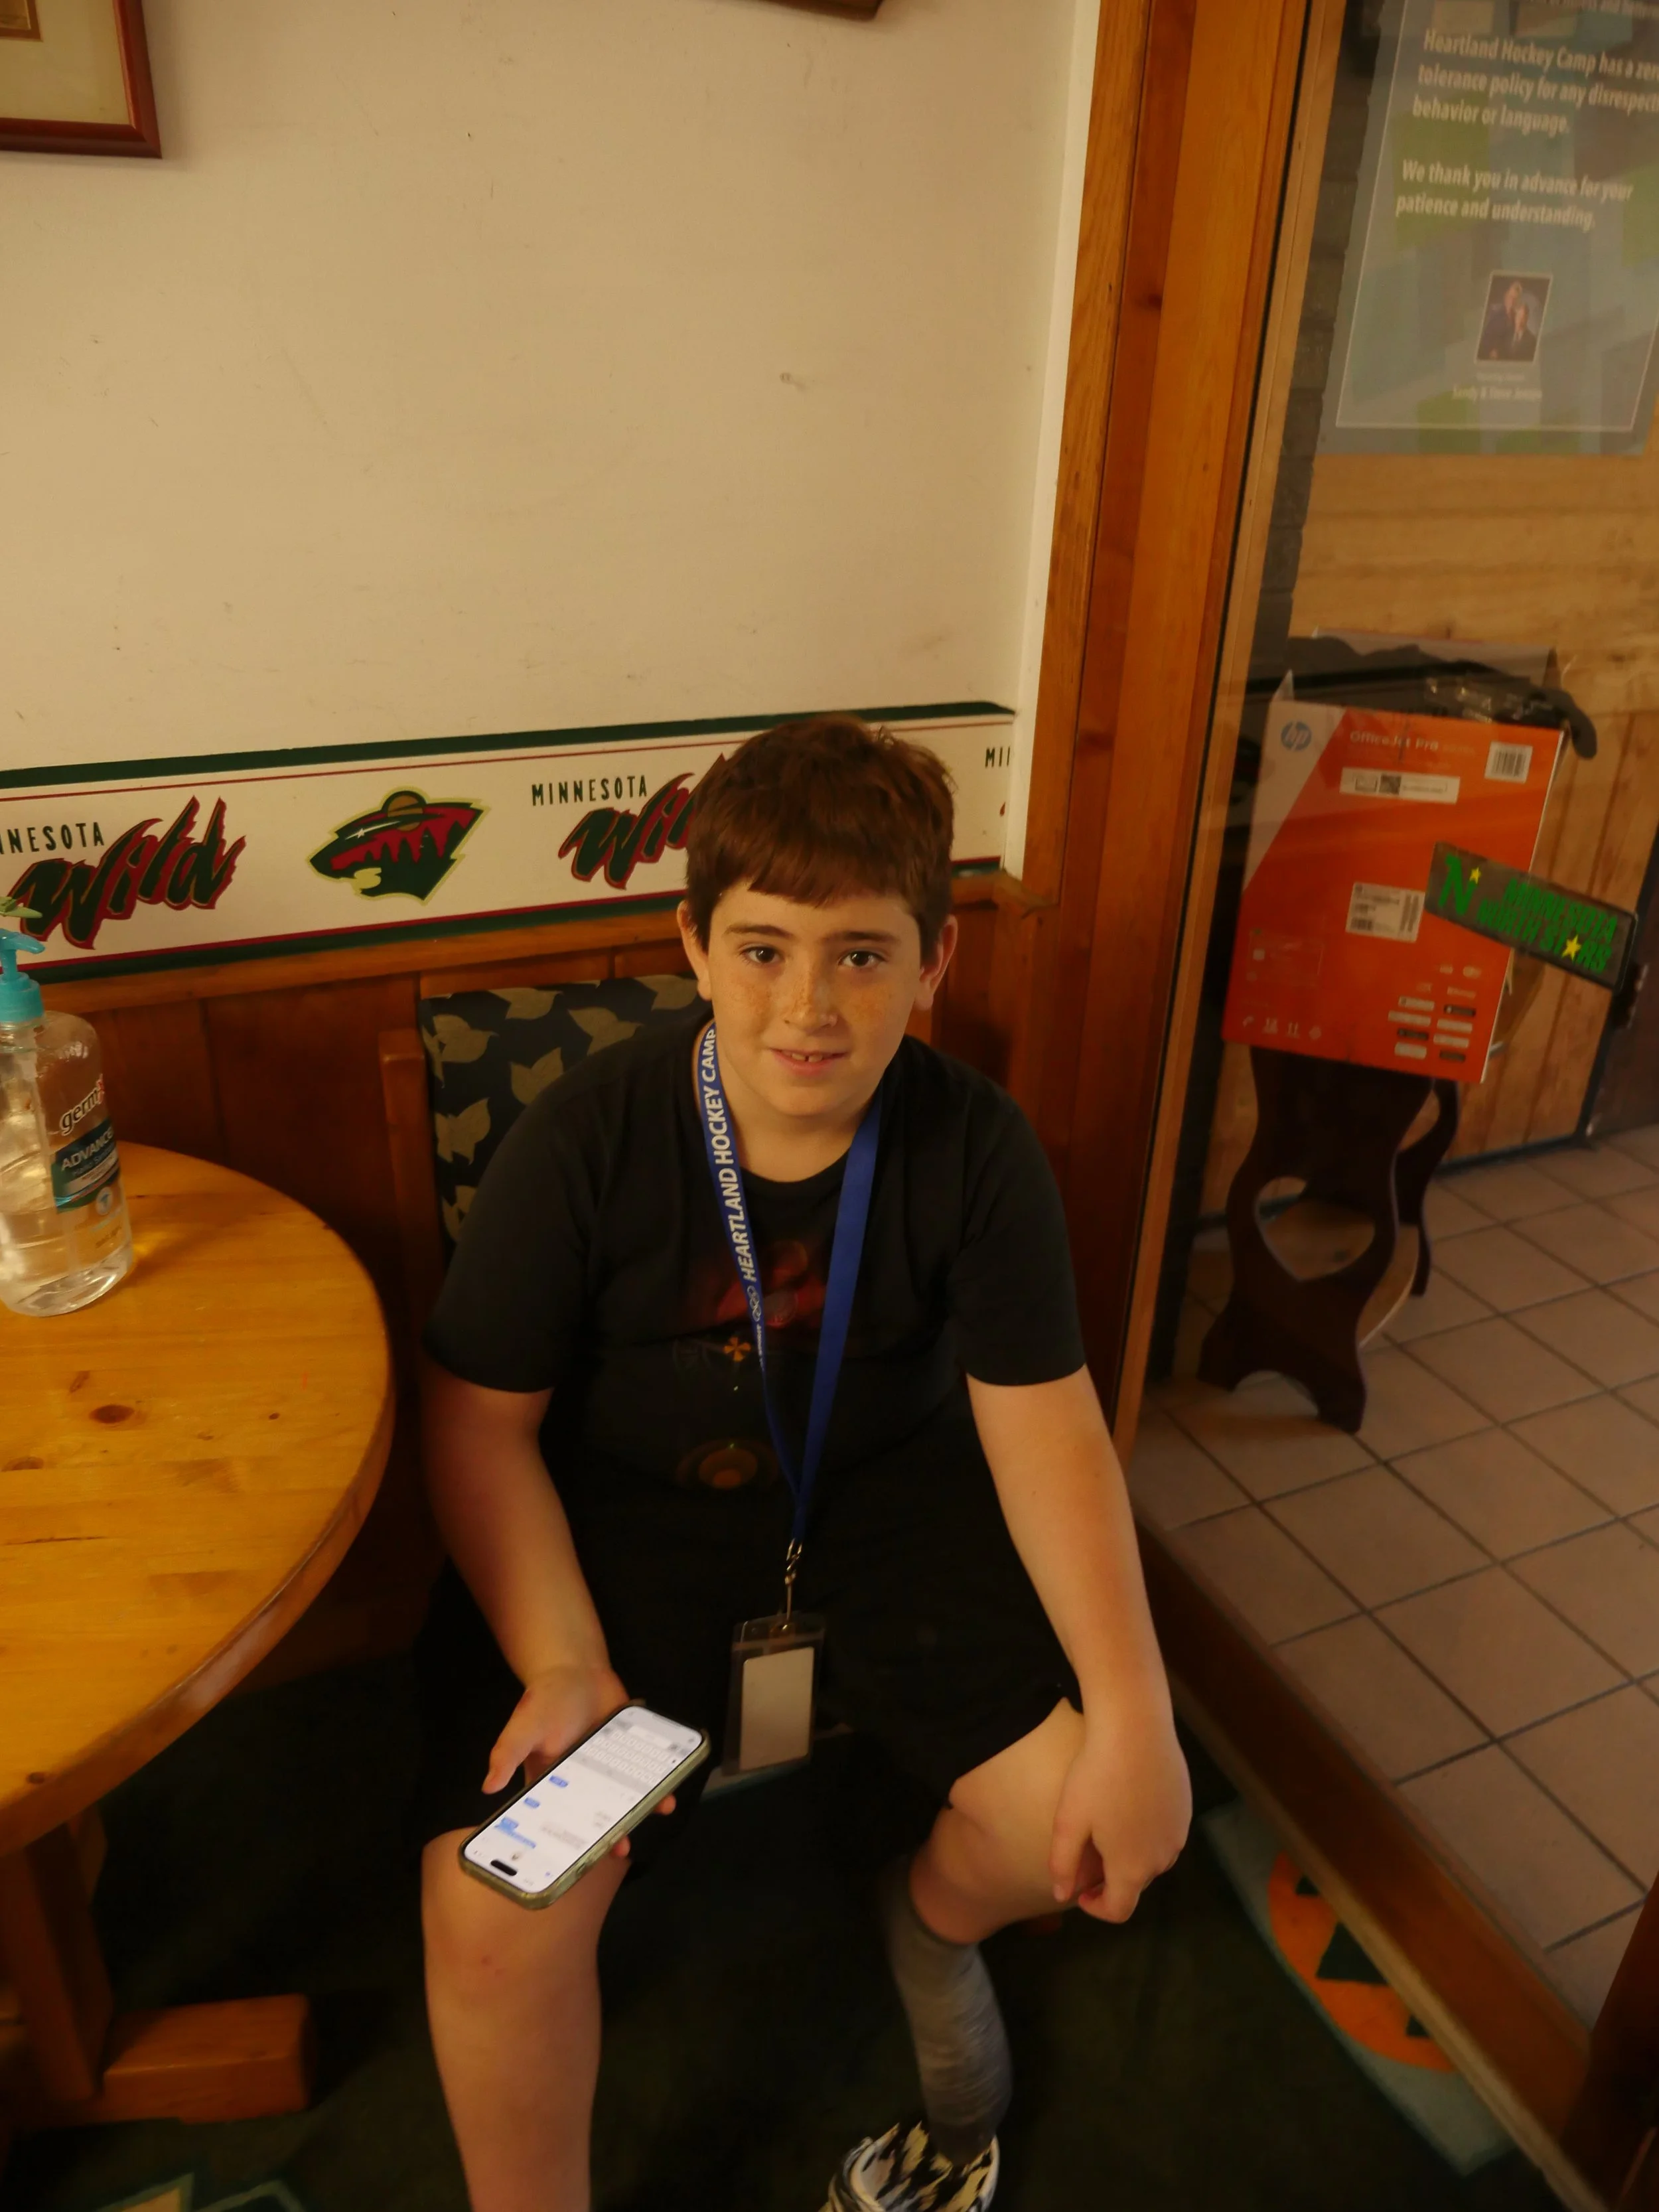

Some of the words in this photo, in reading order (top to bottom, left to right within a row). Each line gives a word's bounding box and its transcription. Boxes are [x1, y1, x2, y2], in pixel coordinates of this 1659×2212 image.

[1423, 28, 1499, 60] Heartland
[1501, 37, 1553, 72] Hockey
[1557, 45, 1596, 78] Camp
[1599, 50, 1623, 76] has
[1625, 58, 1633, 78] a
[1412, 94, 1479, 125] behavior
[1481, 108, 1498, 125] or
[1417, 62, 1487, 92] tolerance
[1489, 72, 1534, 104] policy
[1536, 76, 1558, 100] for
[1561, 86, 1586, 110] any
[1396, 191, 1458, 218] patience
[1461, 197, 1489, 220] and
[1402, 159, 1425, 183] We
[1428, 161, 1471, 188] thank
[1473, 169, 1502, 194] you
[1503, 167, 1518, 191] in
[1520, 169, 1577, 198] advance
[1580, 174, 1599, 198] for
[1600, 183, 1634, 204] your
[1283, 720, 1311, 751] hp
[531, 774, 648, 807] MINNESOTA
[1476, 898, 1542, 946] NORTH
[1502, 876, 1619, 945] MINNESOTA
[701, 1028, 717, 1083] CAMP
[703, 1086, 735, 1166] HOCKEY
[718, 1167, 758, 1284] HEARTLAND
